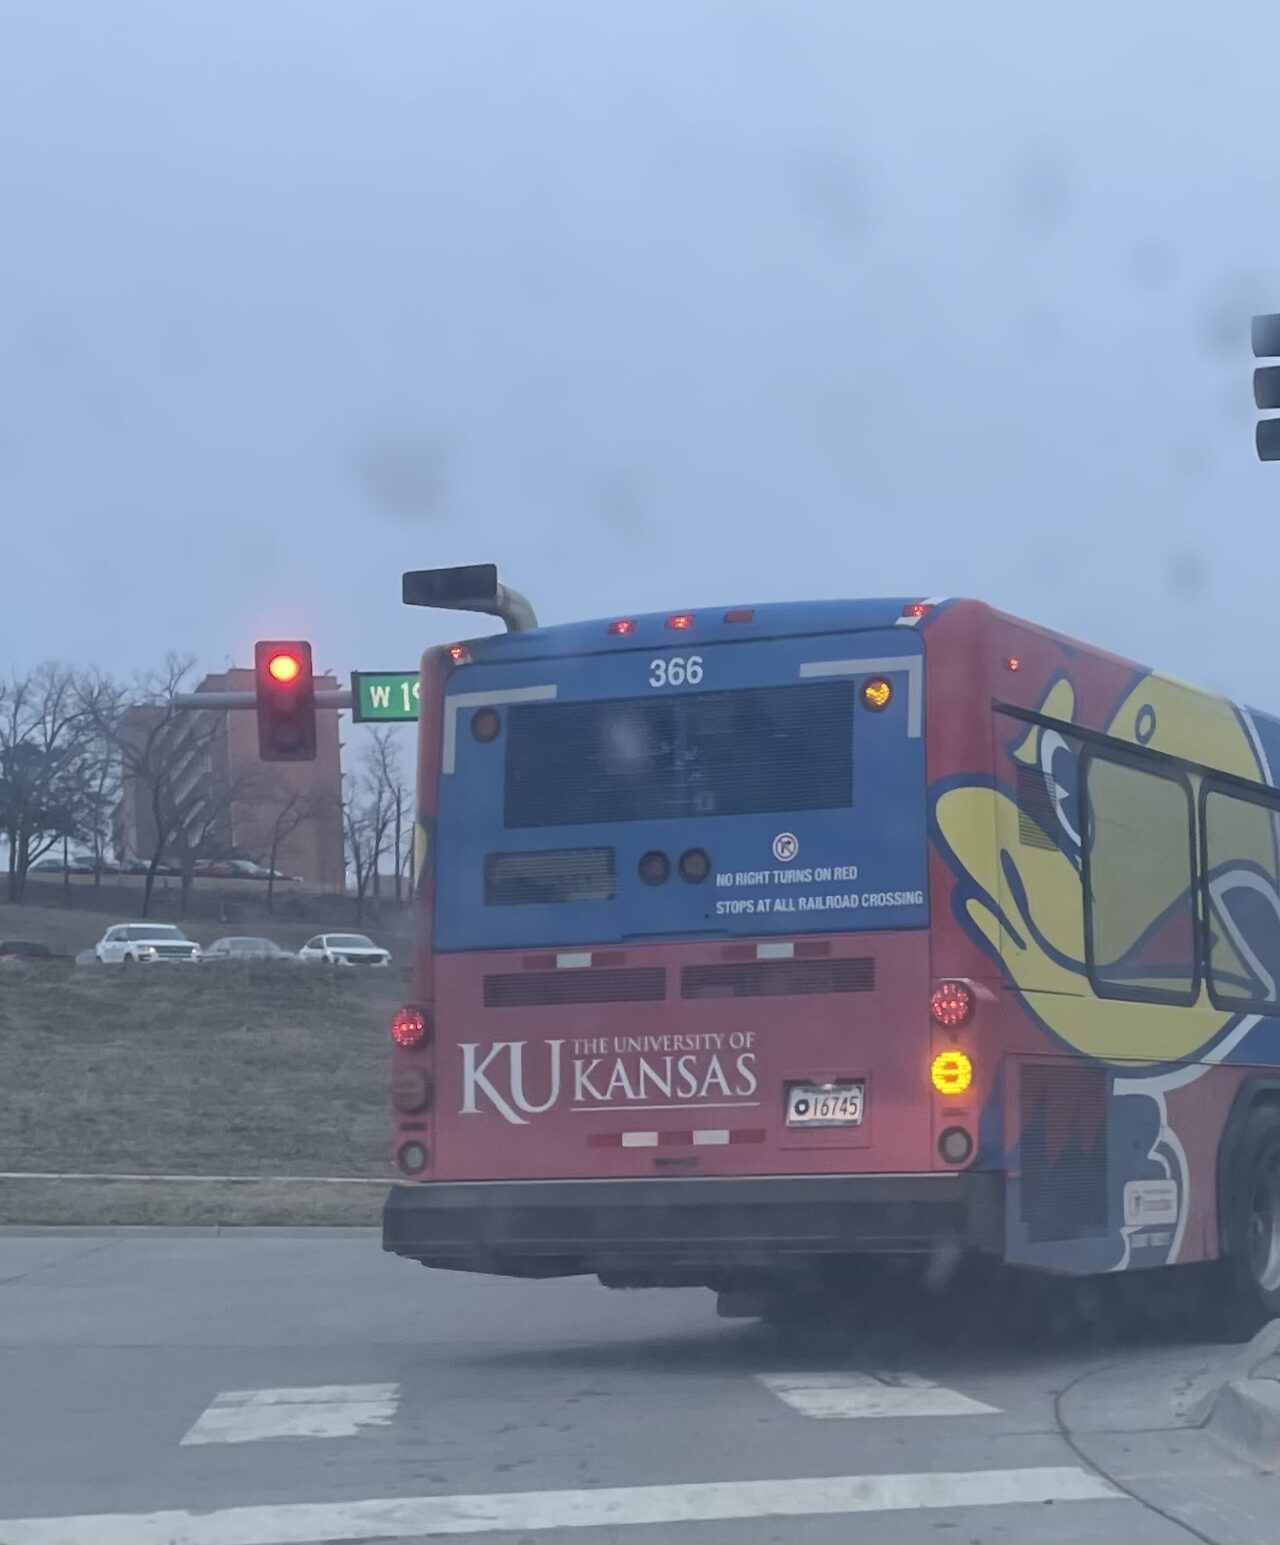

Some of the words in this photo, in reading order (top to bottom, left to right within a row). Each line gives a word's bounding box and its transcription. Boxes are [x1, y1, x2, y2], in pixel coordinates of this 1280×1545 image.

[649, 655, 704, 688] 366
[369, 685, 391, 708] W
[716, 873, 734, 887] NO
[735, 871, 770, 886] RIGHT
[772, 868, 812, 884] TURNS
[814, 867, 832, 882] ON
[833, 865, 858, 881] RED
[716, 900, 755, 914] STOPS
[756, 898, 771, 913] AT
[773, 897, 796, 912] ALL
[798, 894, 860, 911] RAILROAD
[861, 890, 924, 908] CROSSING
[571, 1037, 609, 1055] THE
[612, 1033, 726, 1053] UNIVERSITY
[728, 1031, 756, 1049] OF
[456, 1039, 566, 1125] KU
[572, 1052, 758, 1101] KANSAS
[812, 1095, 859, 1117] 16745
